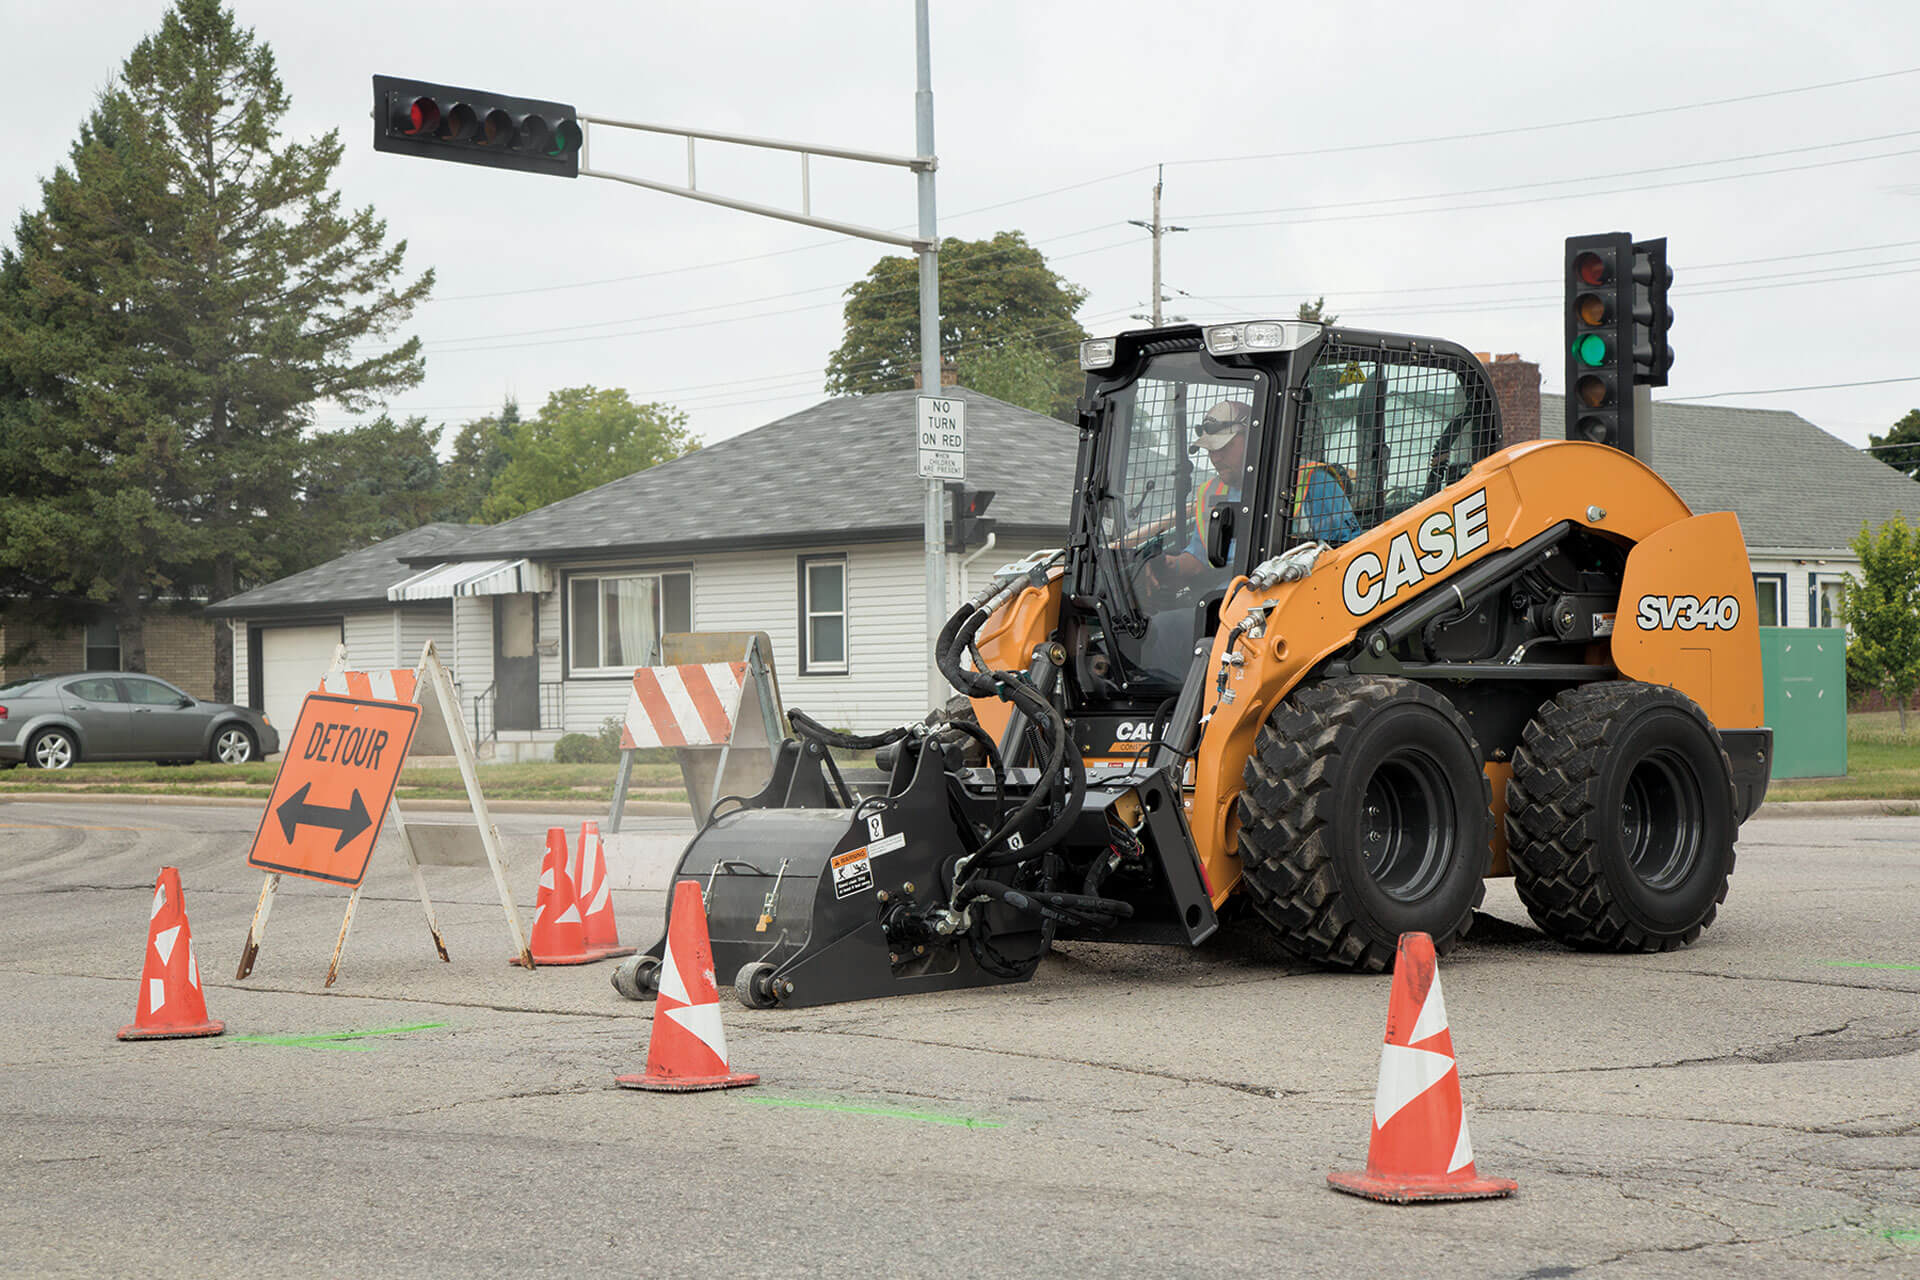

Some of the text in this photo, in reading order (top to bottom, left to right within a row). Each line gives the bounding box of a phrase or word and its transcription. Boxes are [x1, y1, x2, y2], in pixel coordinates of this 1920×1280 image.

[933, 401, 951, 413] NO
[928, 416, 956, 430] TURN
[922, 432, 962, 448] ON RED
[1342, 486, 1490, 617] CASE
[1636, 594, 1741, 631] SV340
[303, 721, 389, 771] DETOUR
